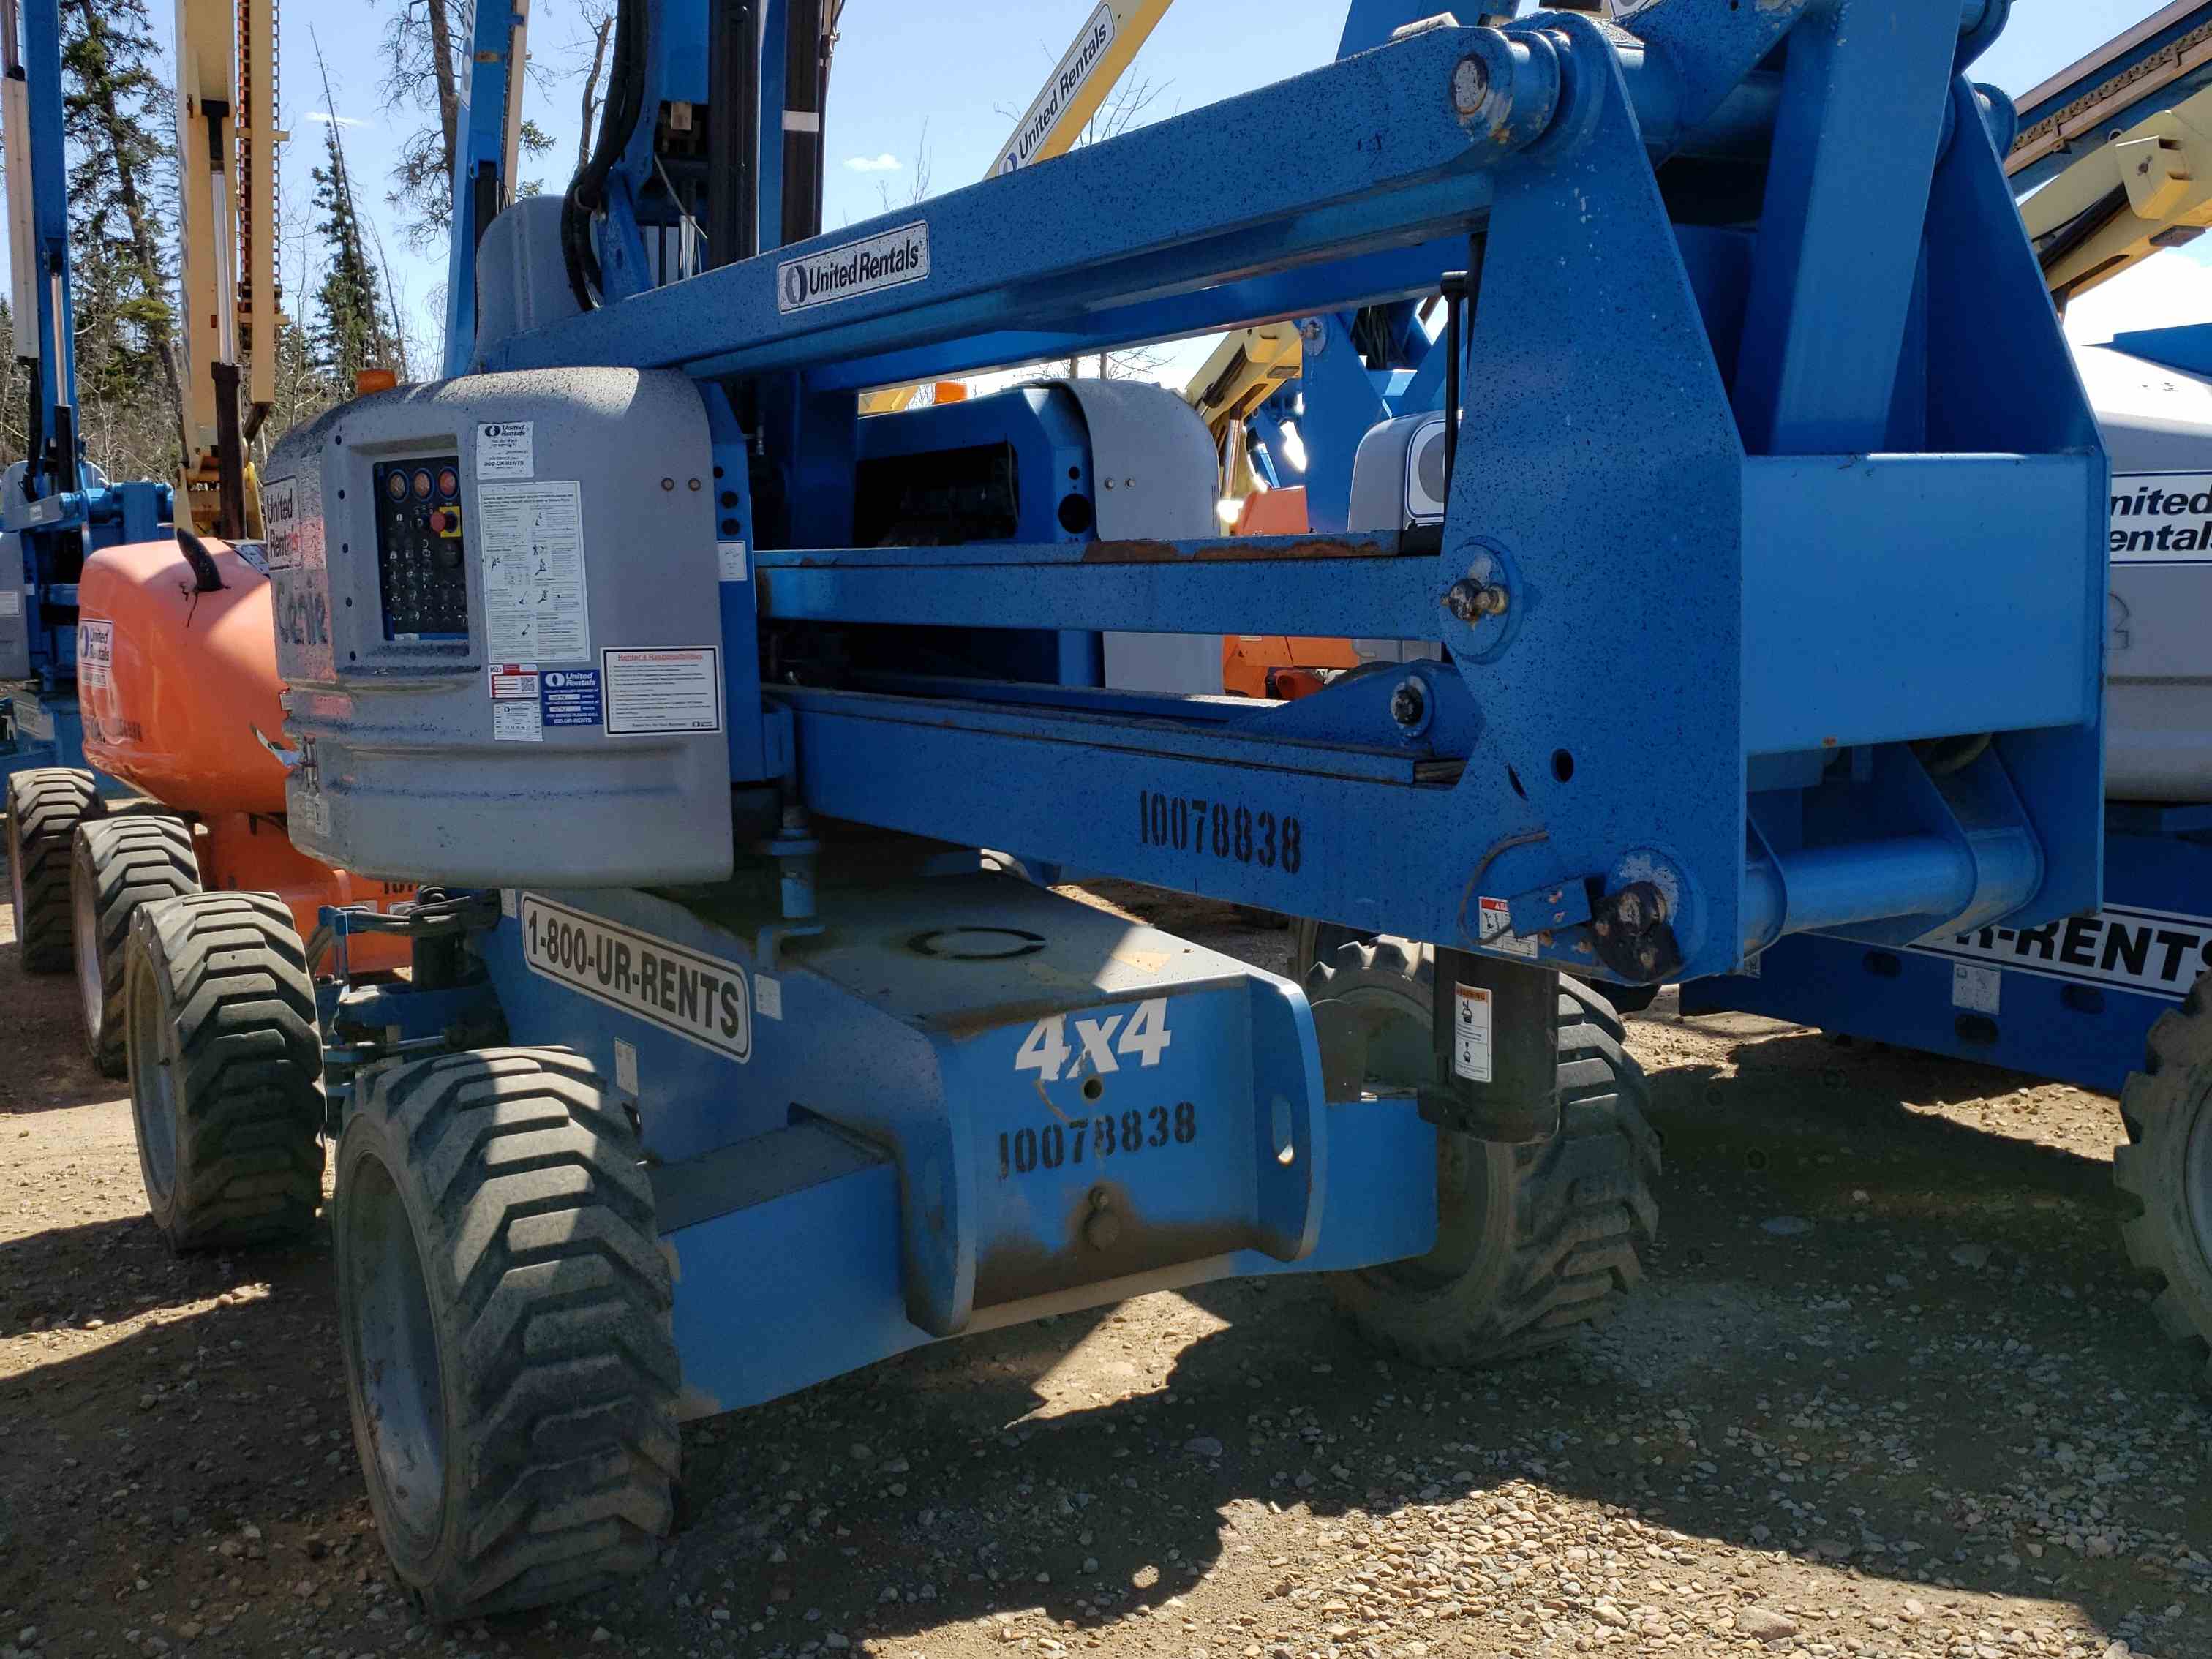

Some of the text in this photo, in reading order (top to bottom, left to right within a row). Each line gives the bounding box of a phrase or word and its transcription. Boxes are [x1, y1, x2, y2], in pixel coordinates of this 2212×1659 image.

[1019, 23, 1107, 160] United Rentals
[809, 240, 919, 296] United Rentals
[266, 488, 293, 524] United
[2110, 484, 2212, 516] nited
[2110, 520, 2212, 552] ental
[1140, 790, 1301, 874] 10078838
[528, 909, 740, 1039] 1-800-UR-RENTS
[1955, 917, 2212, 982] -RENT
[999, 1101, 1197, 1180] 10078838
